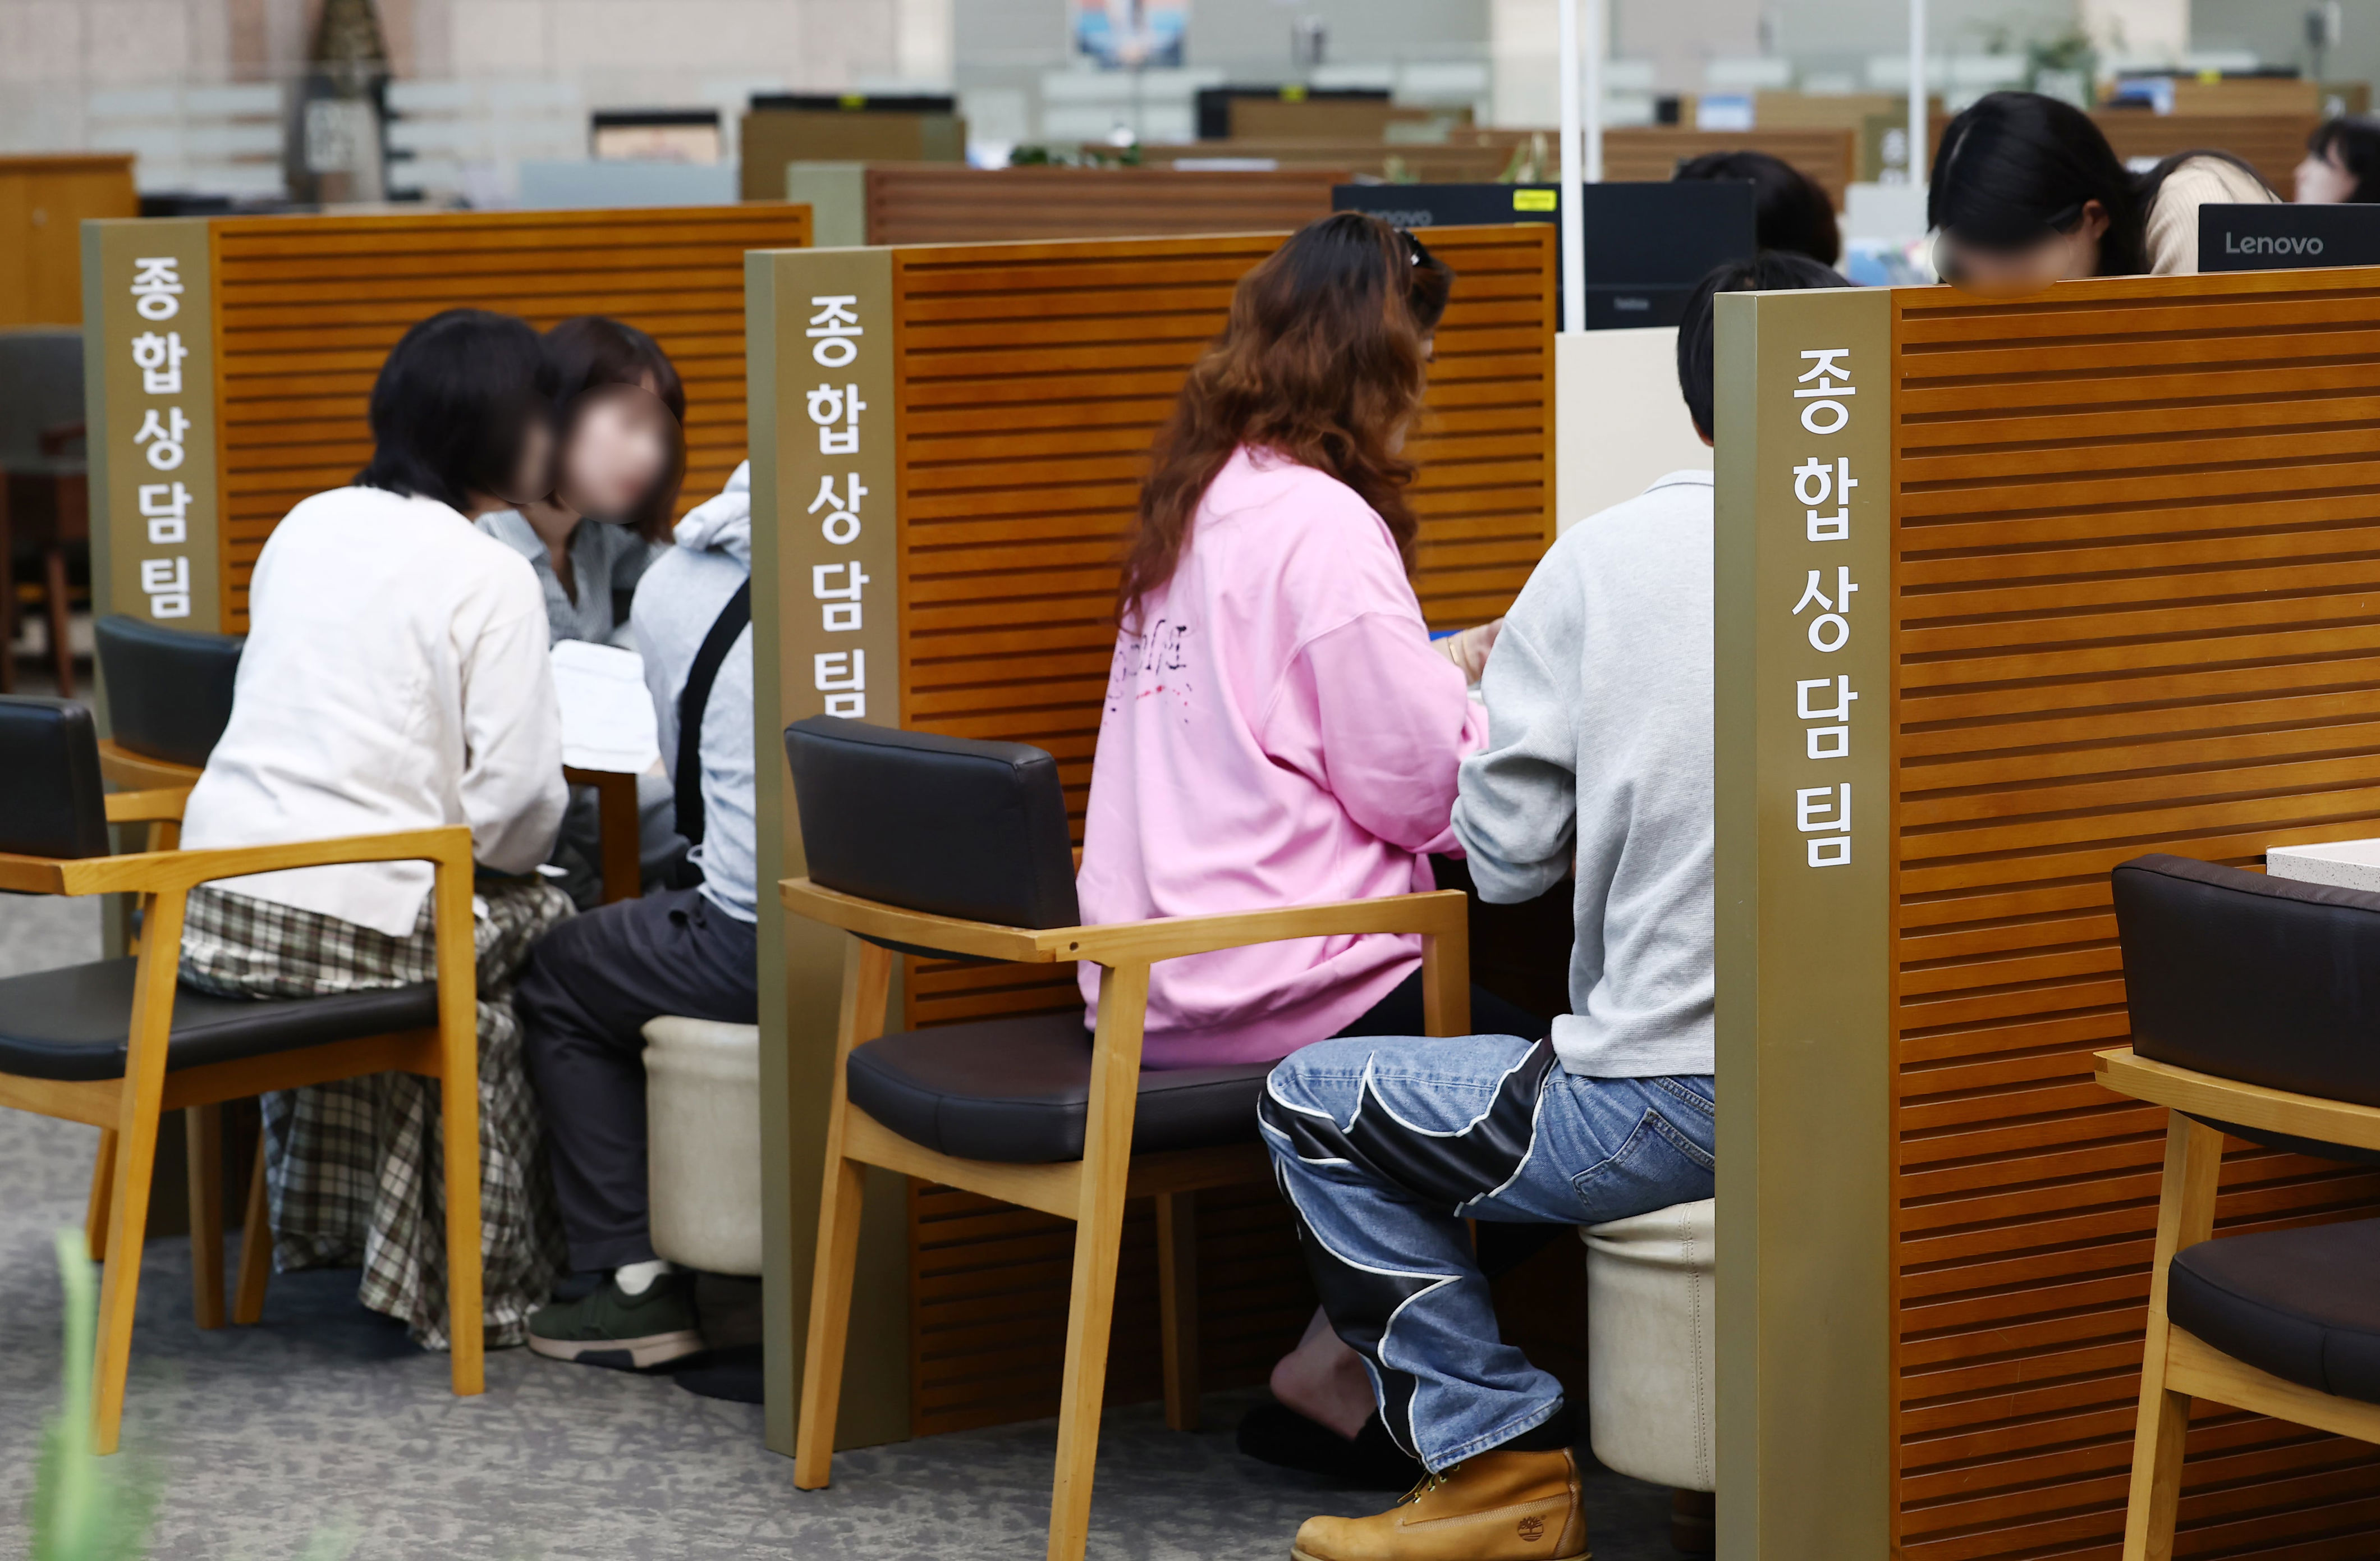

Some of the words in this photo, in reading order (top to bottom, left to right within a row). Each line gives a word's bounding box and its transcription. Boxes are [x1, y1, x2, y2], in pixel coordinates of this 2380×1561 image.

[131, 257, 192, 619] 종합상담팀
[2226, 231, 2324, 255] Lenovo
[805, 295, 870, 719] 종합상담팀
[1791, 348, 1859, 868] 종합상담팀
